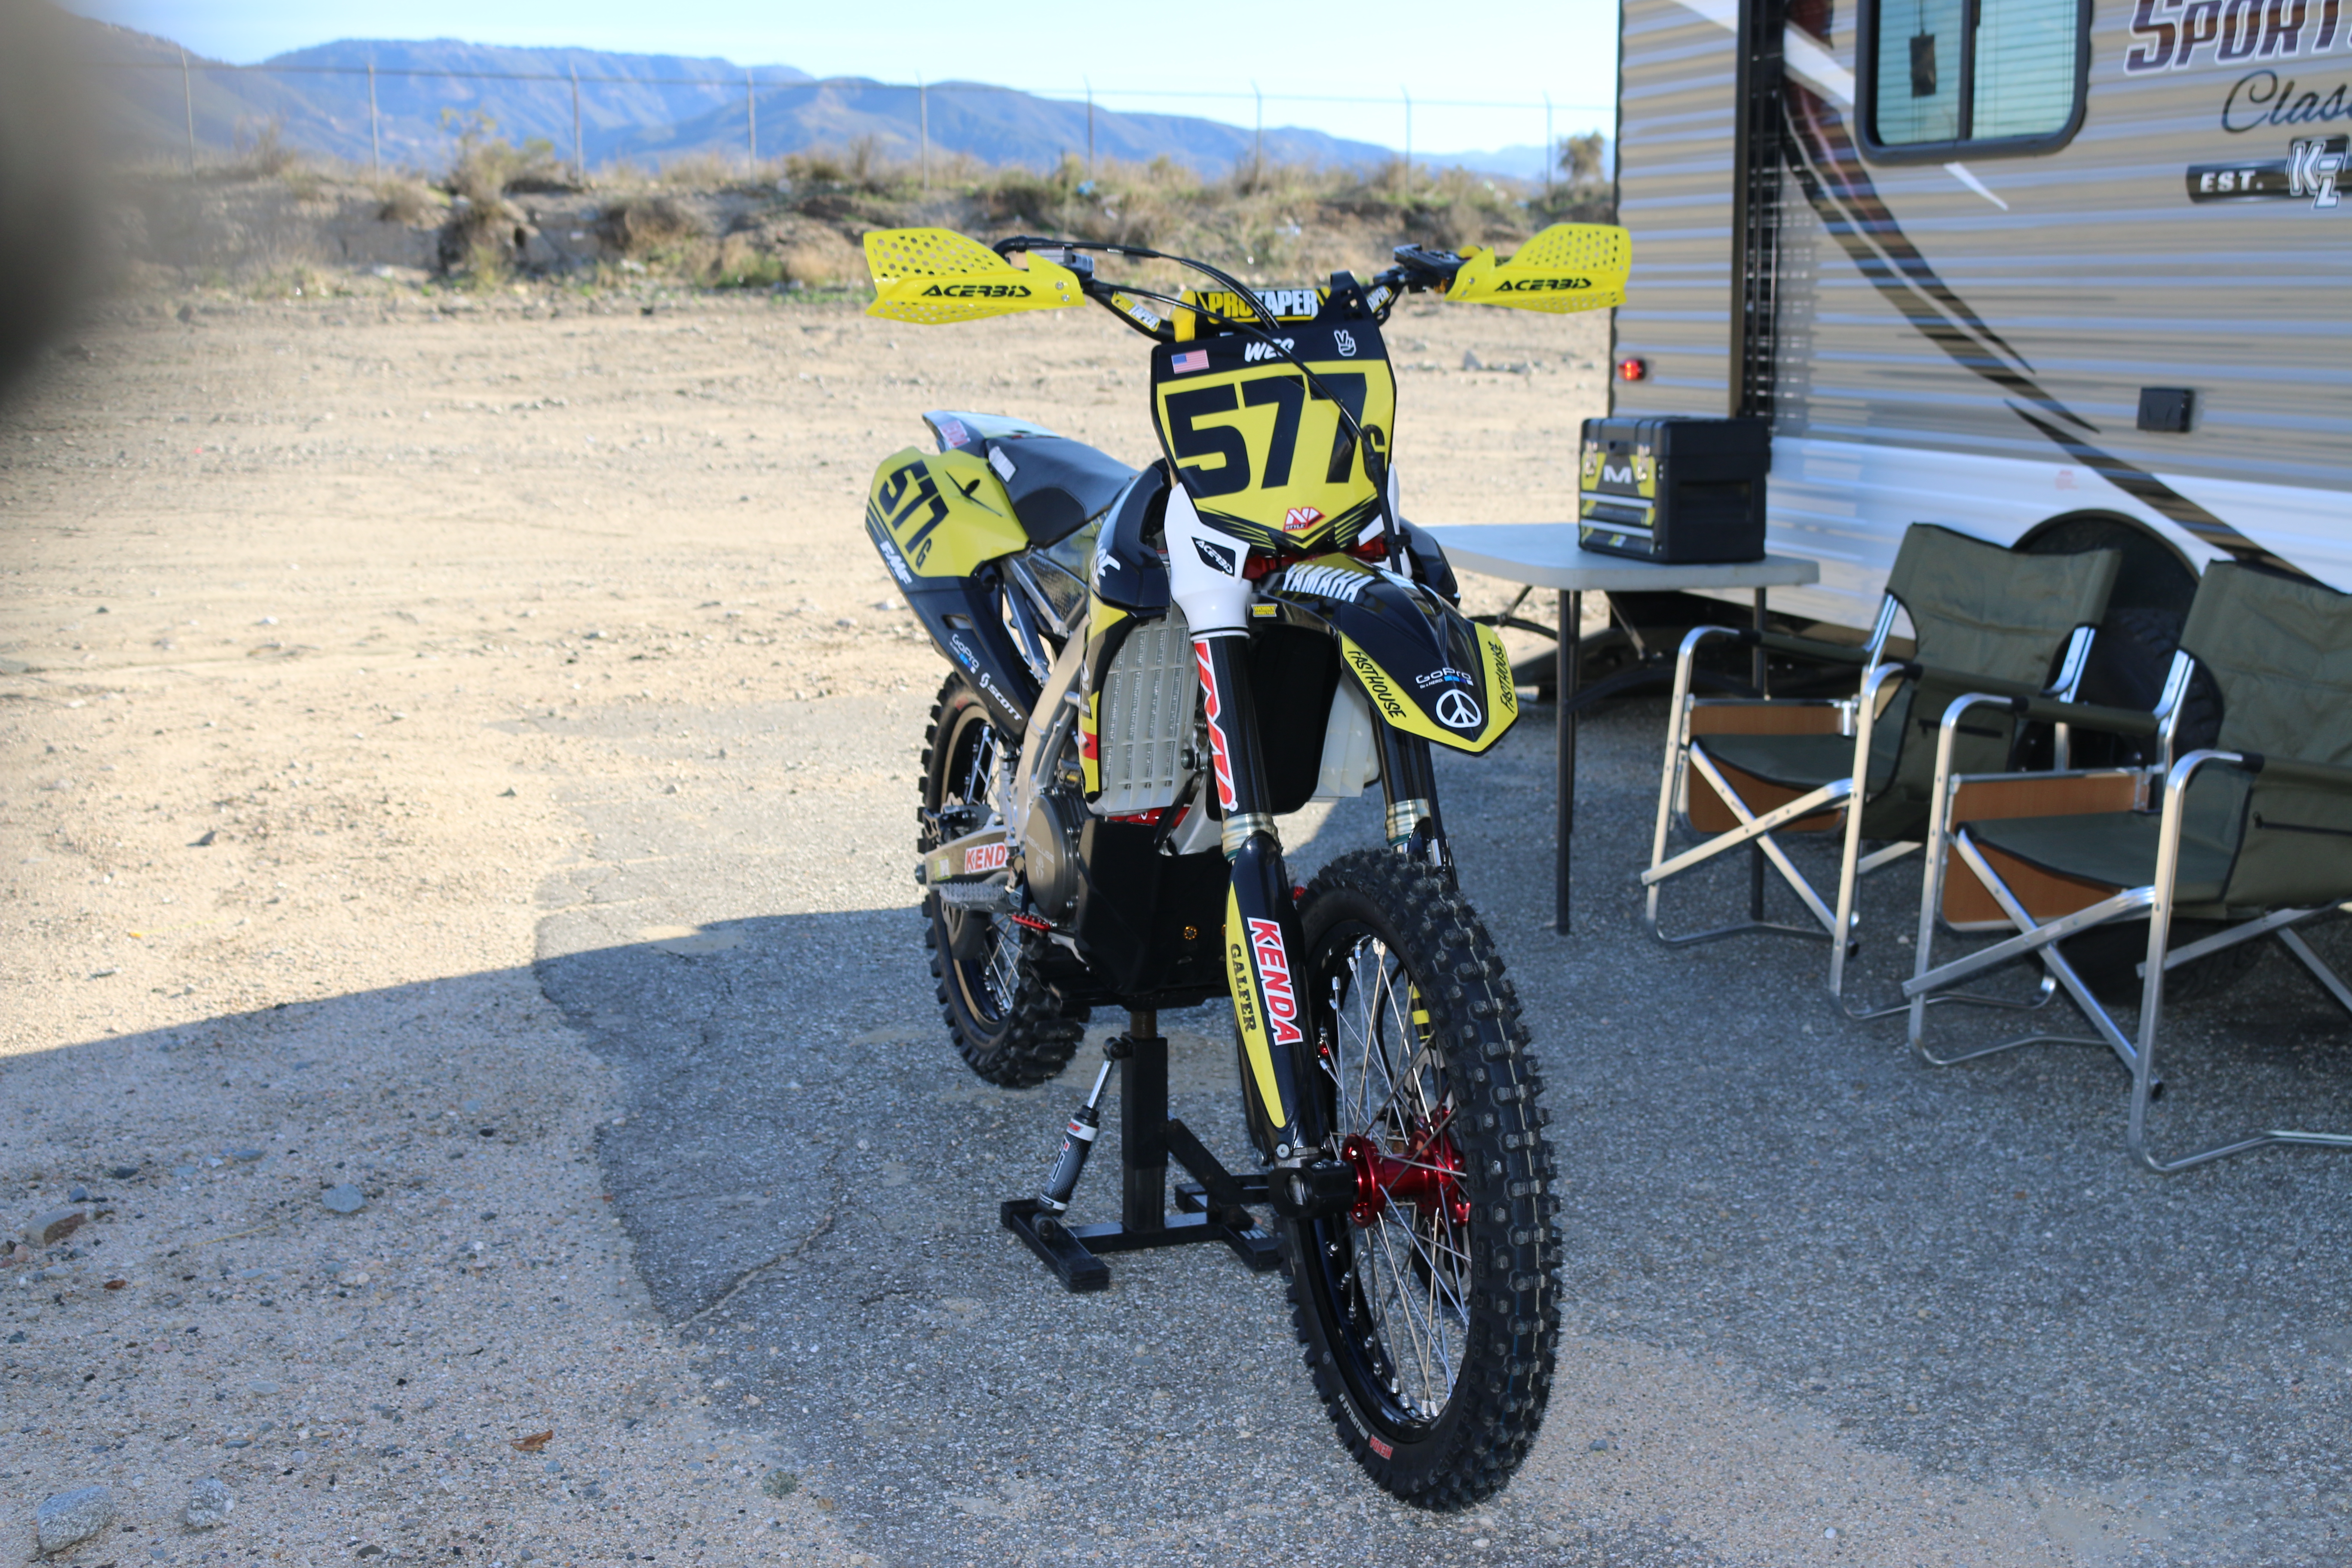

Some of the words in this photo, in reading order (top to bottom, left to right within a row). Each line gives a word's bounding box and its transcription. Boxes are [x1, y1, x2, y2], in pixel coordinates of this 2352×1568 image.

[2123, 0, 2352, 76] SPORT
[2221, 69, 2352, 134] Clas
[2200, 171, 2263, 192] EST.
[921, 285, 1032, 297] ACERBIS
[1495, 278, 1592, 291] ACERBIS
[1244, 337, 1295, 362] WES
[1165, 373, 1367, 499] 577
[1603, 465, 1632, 484] M
[879, 459, 949, 555] 577
[1195, 540, 1233, 574] ACERBIS
[1282, 564, 1375, 603] YAMAHA
[952, 633, 980, 669] GoPro
[1347, 651, 1406, 719] FASTHOUSE
[1415, 667, 1471, 684] GoPro
[1488, 640, 1515, 714] FASTHOUSE
[987, 684, 1022, 721] SCOTT
[965, 844, 1007, 873] KEND
[1230, 943, 1257, 1032] GALFER
[1248, 918, 1303, 1045] KENDA
[1370, 1434, 1393, 1460] KENDA
